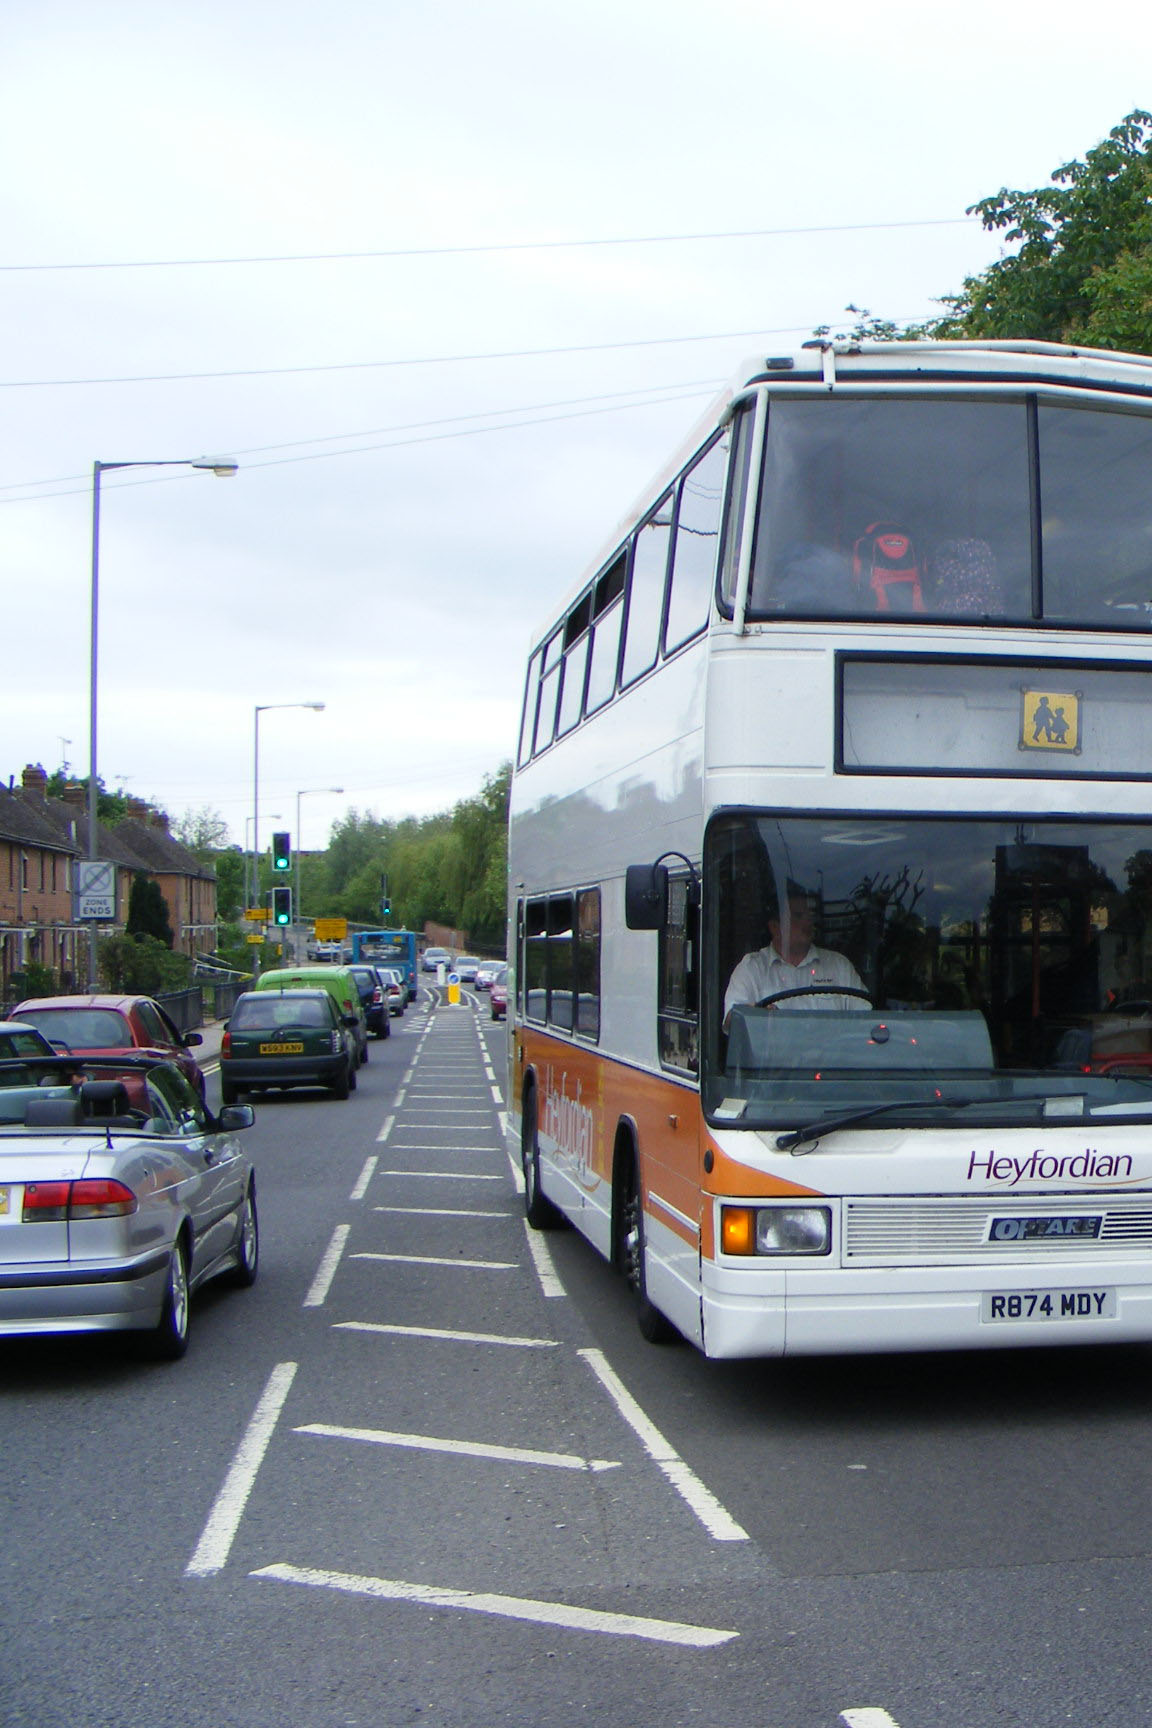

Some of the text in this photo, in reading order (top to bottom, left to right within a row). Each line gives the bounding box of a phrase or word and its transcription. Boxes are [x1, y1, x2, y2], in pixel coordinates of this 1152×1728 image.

[83, 906, 112, 915] ENDS
[544, 1063, 593, 1173] Heyfordian
[967, 1148, 1133, 1187] Heyfordian
[991, 1292, 1107, 1319] R874 MDY
